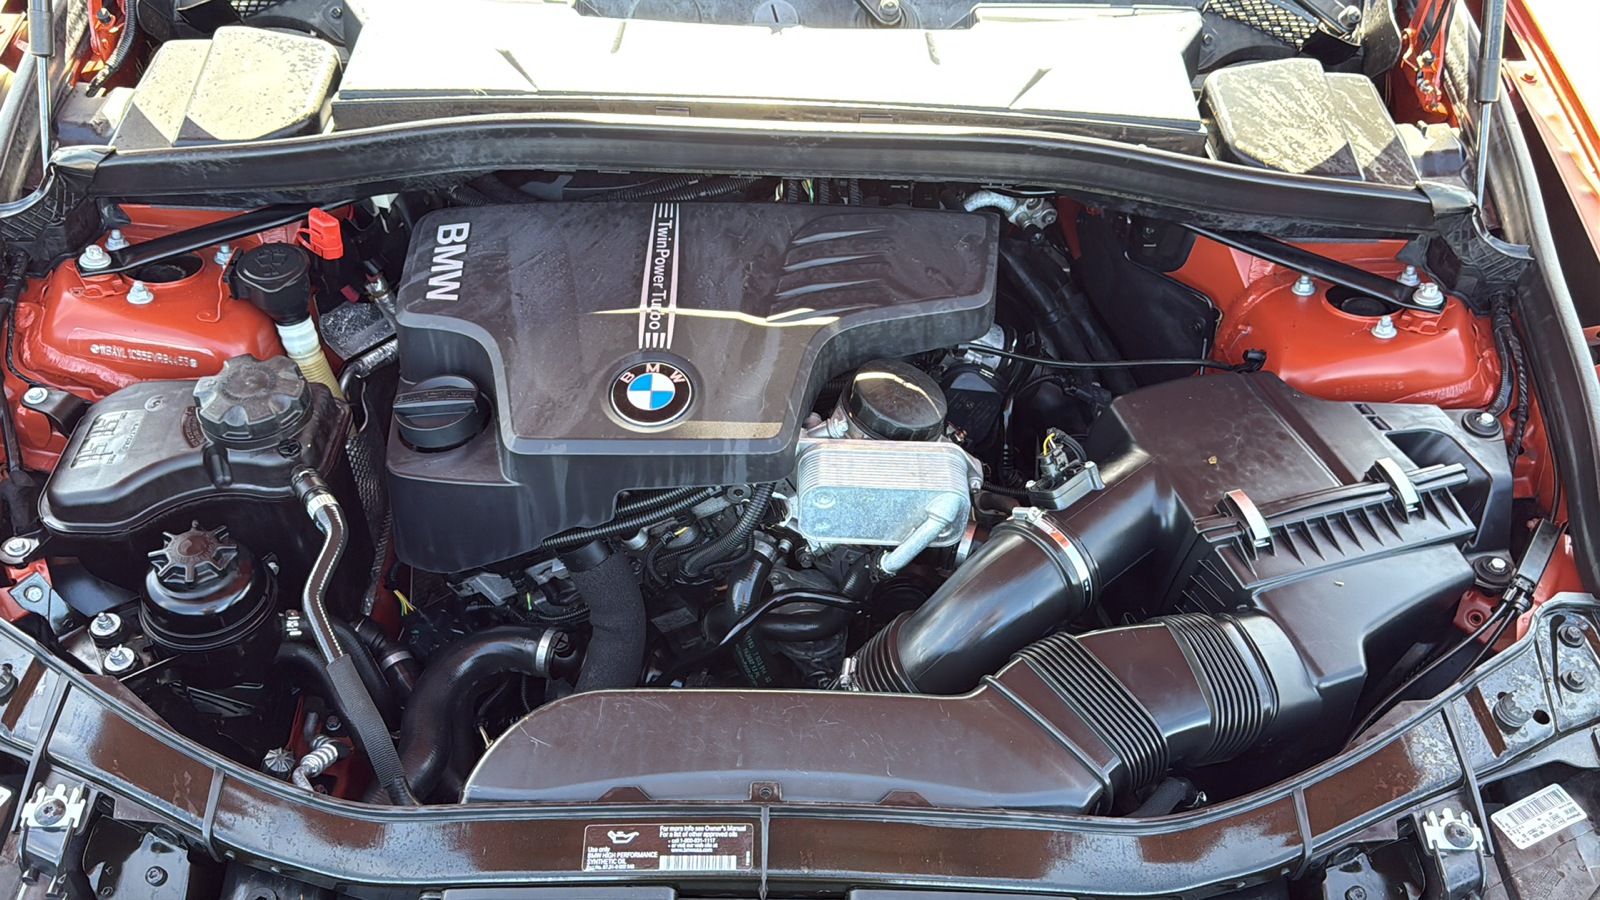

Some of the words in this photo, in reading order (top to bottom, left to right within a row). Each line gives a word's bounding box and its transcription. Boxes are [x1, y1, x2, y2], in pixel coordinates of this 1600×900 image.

[426, 222, 470, 301] BMW
[652, 219, 672, 288] TwinPower
[648, 289, 667, 330] Turbo
[620, 363, 685, 384] BMW
